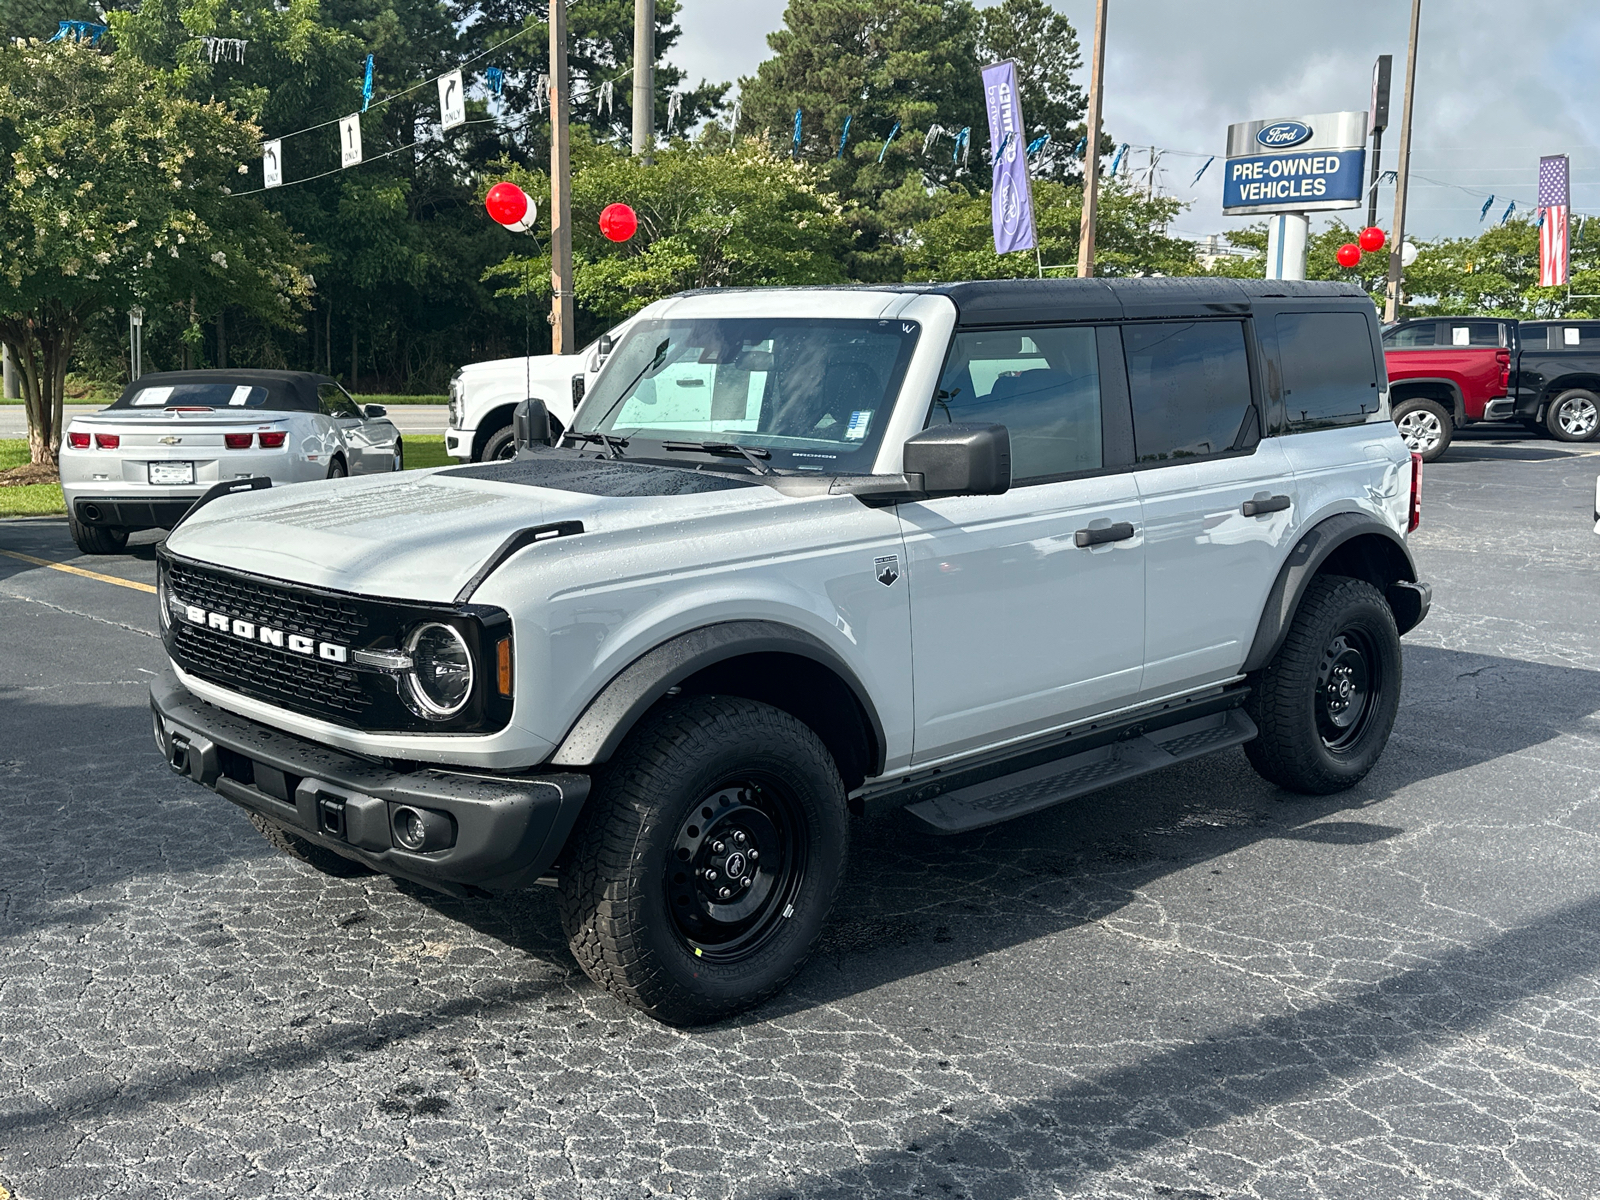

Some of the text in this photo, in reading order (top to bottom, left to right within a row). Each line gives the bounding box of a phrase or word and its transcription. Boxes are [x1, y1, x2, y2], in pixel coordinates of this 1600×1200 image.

[444, 108, 461, 124] ONLY
[1266, 126, 1297, 143] Ford
[344, 149, 358, 162] ONLY
[266, 172, 278, 183] ONLY
[1232, 156, 1340, 182] PRE-OWNED
[1239, 178, 1326, 201] VEHICLES
[187, 605, 347, 663] BRONCO
